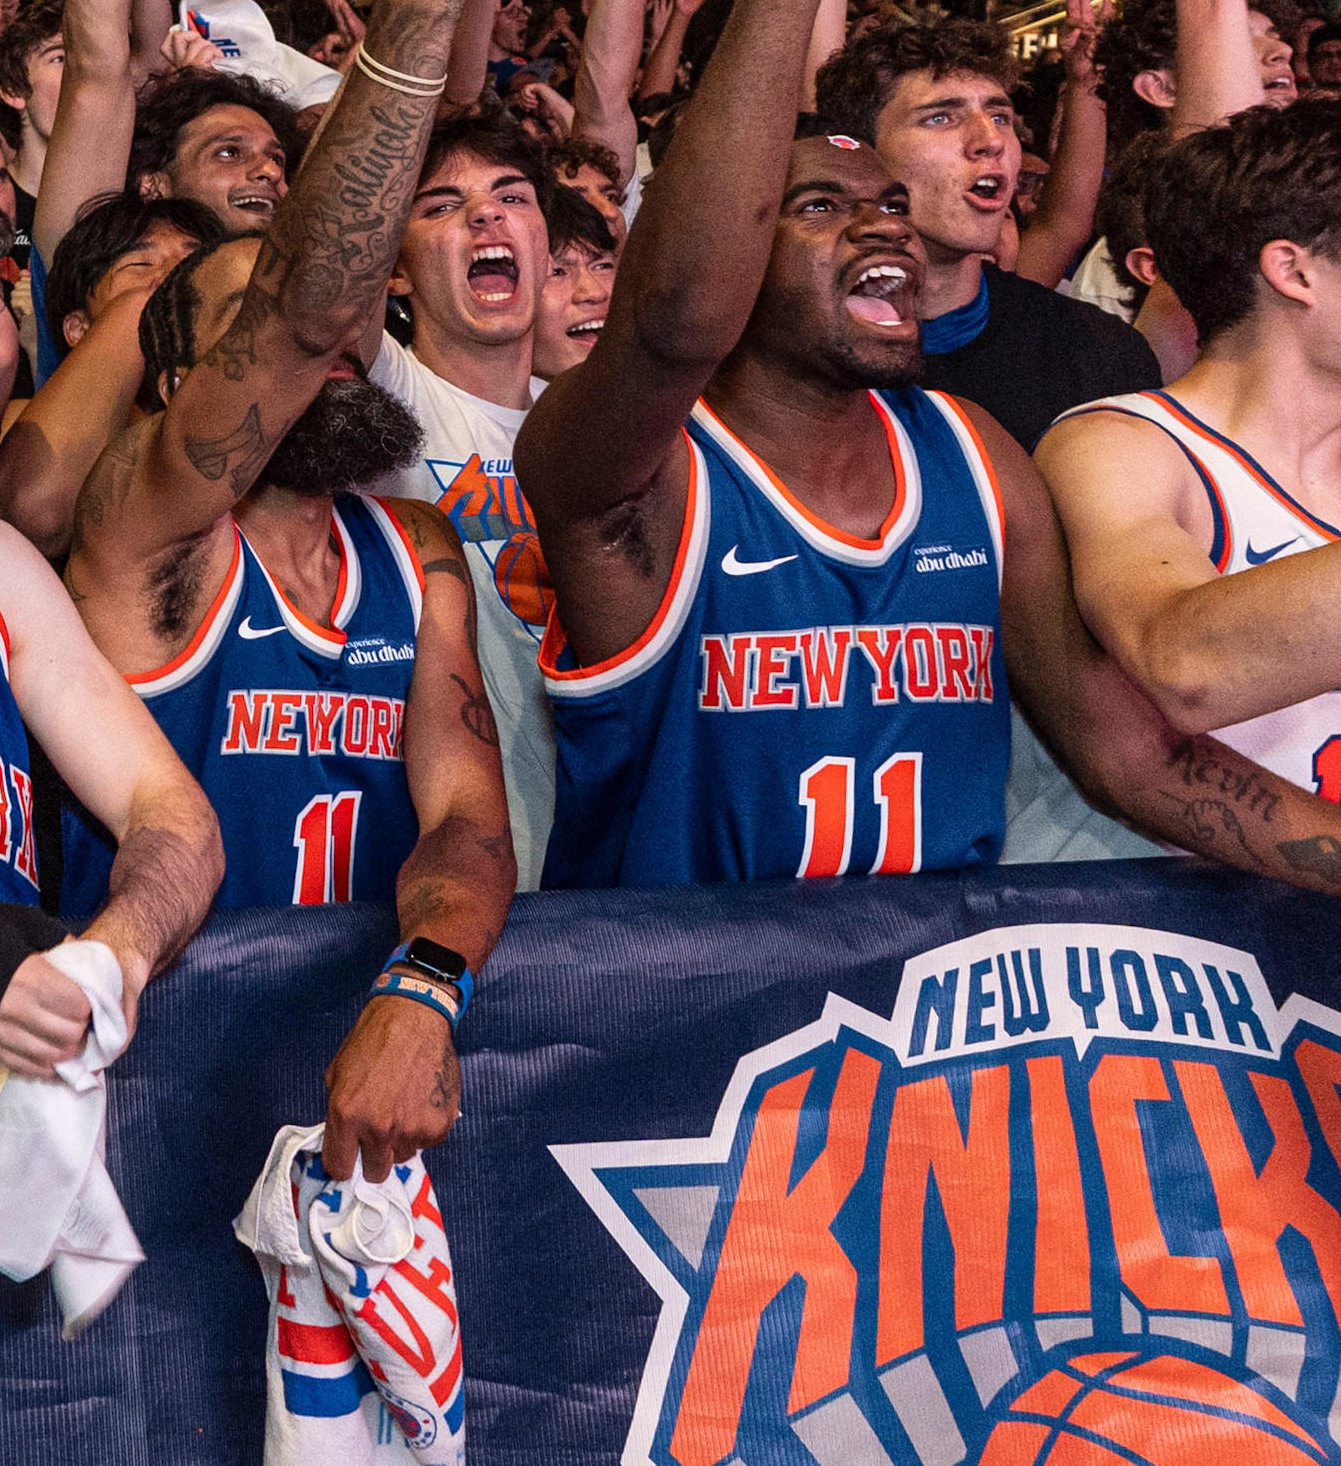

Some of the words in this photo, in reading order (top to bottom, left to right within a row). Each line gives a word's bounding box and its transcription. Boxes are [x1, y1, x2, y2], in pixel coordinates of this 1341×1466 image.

[916, 554, 946, 573] abu
[947, 548, 988, 570] dhabi
[348, 649, 378, 666] abu
[698, 625, 854, 713] NEW
[853, 622, 994, 707] YORK
[291, 790, 363, 905] 11
[795, 751, 924, 879] 11
[907, 946, 1051, 1059] NEW
[1065, 945, 1275, 1054] YORK
